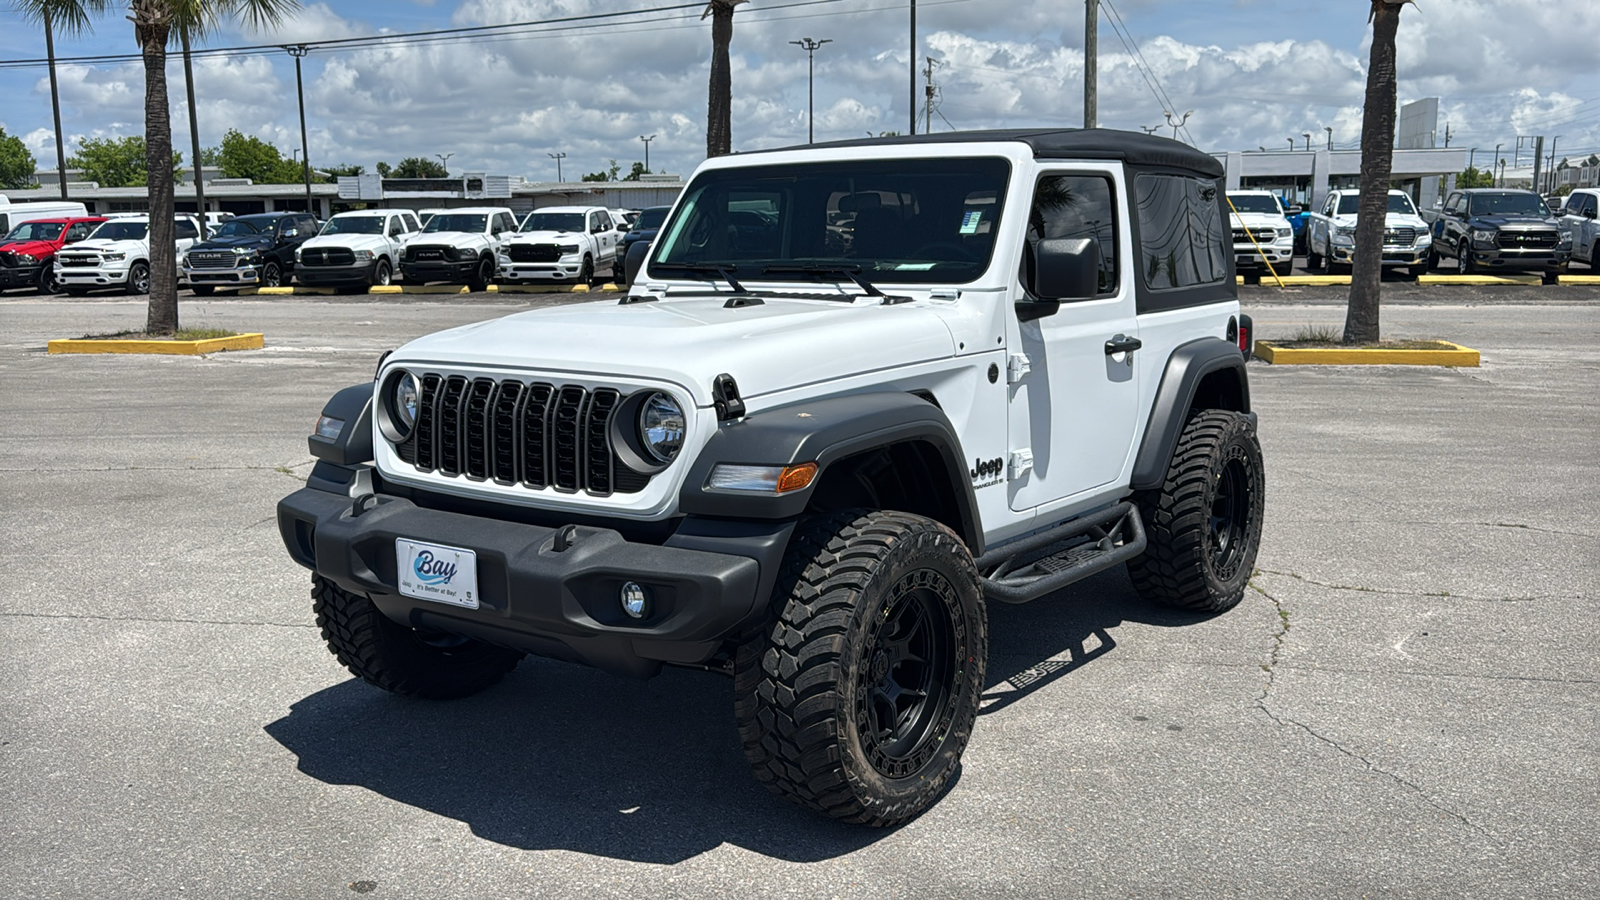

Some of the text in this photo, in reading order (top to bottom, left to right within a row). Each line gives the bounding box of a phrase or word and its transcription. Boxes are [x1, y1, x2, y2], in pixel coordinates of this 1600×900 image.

[971, 457, 1003, 478] Jeep
[416, 550, 458, 585] Bay
[425, 585, 440, 593] Better
[447, 589, 458, 598] Bay!
